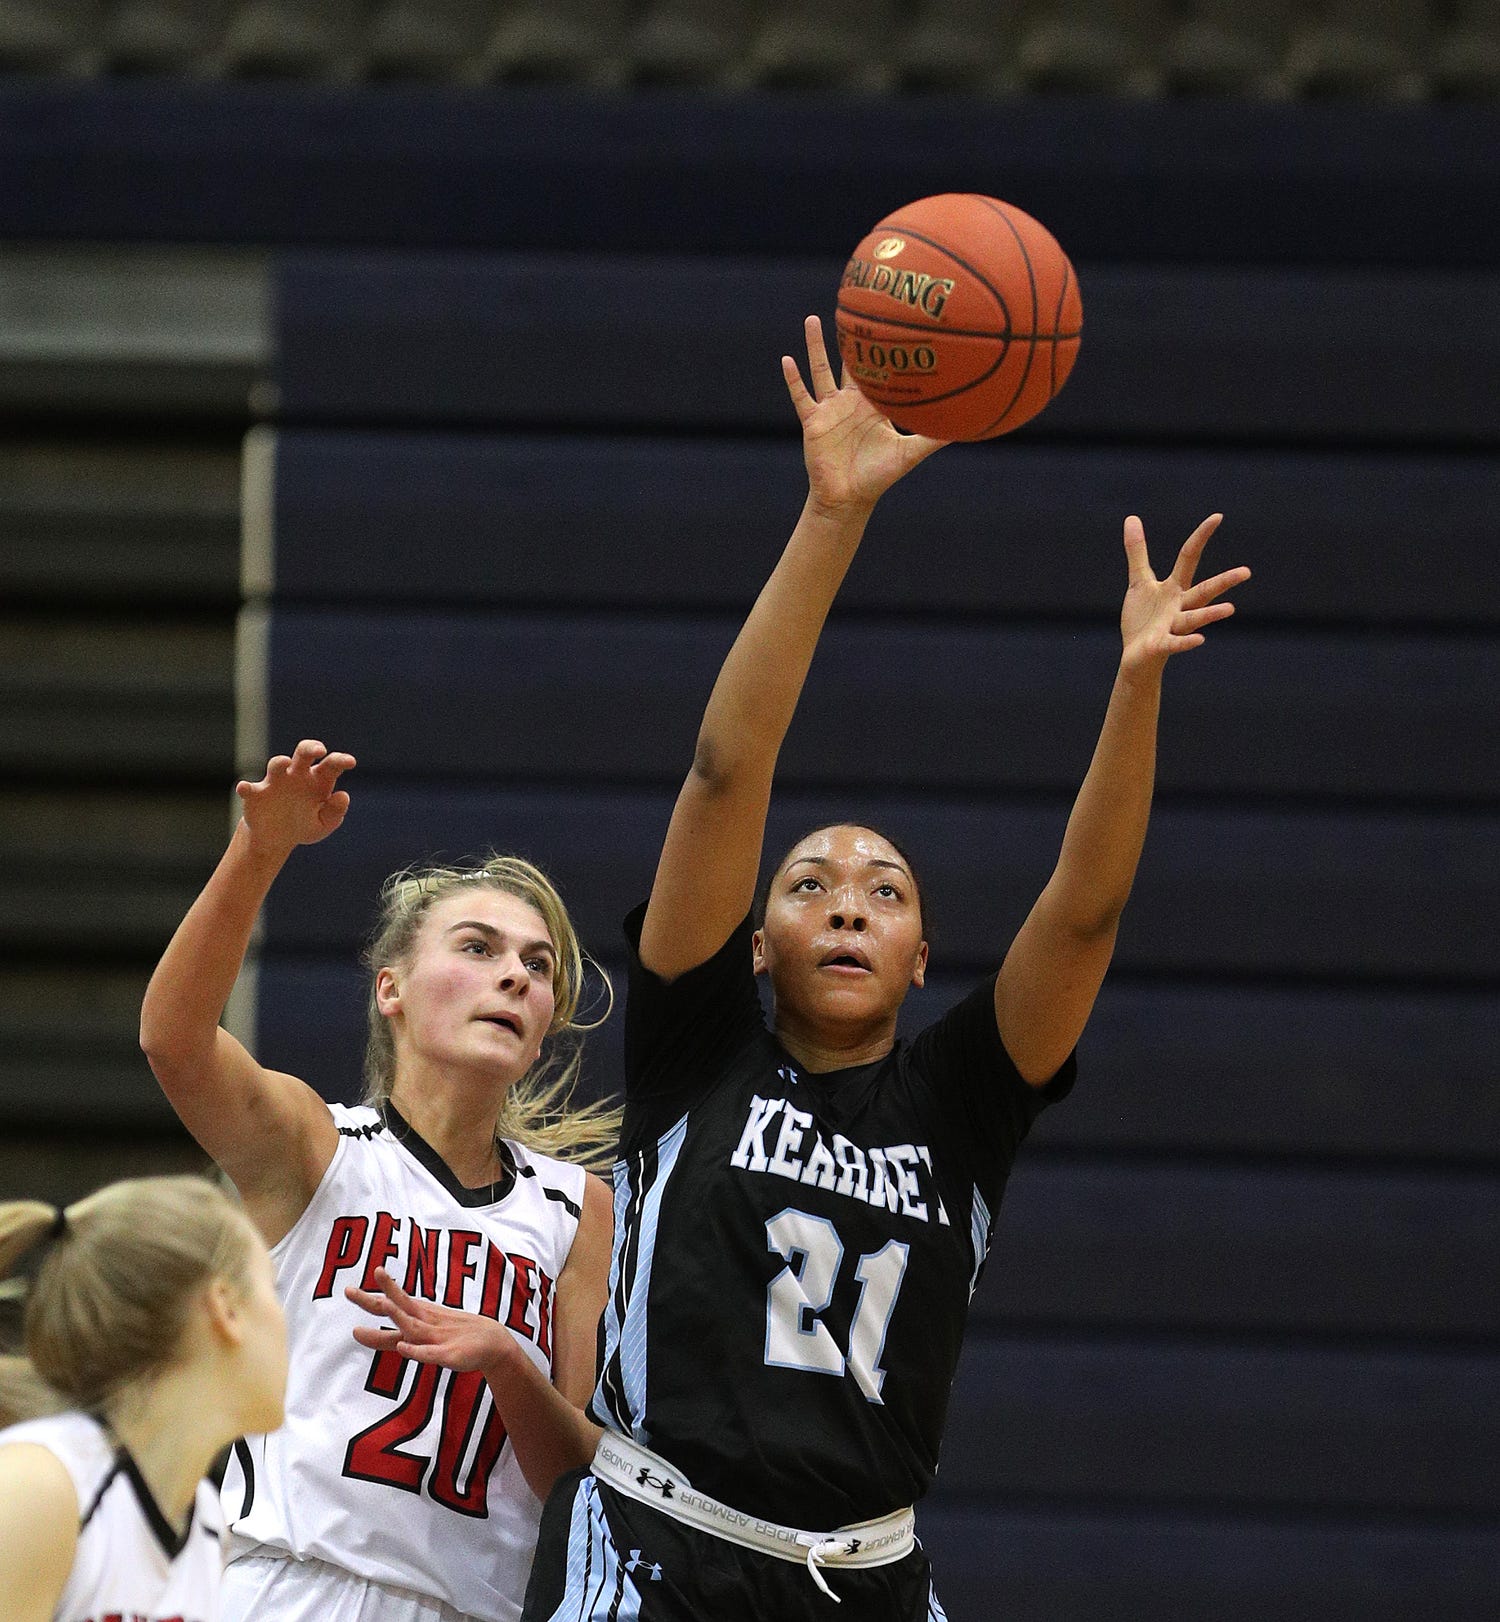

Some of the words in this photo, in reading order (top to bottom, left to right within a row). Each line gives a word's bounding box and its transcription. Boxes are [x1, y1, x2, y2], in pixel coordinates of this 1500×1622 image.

[840, 258, 955, 321] ALDING
[312, 1211, 556, 1365] PENFIEL
[764, 1207, 910, 1406] 21
[341, 1326, 507, 1519] 20
[600, 1446, 634, 1476] UNDER
[680, 1491, 750, 1529] ARMOUR
